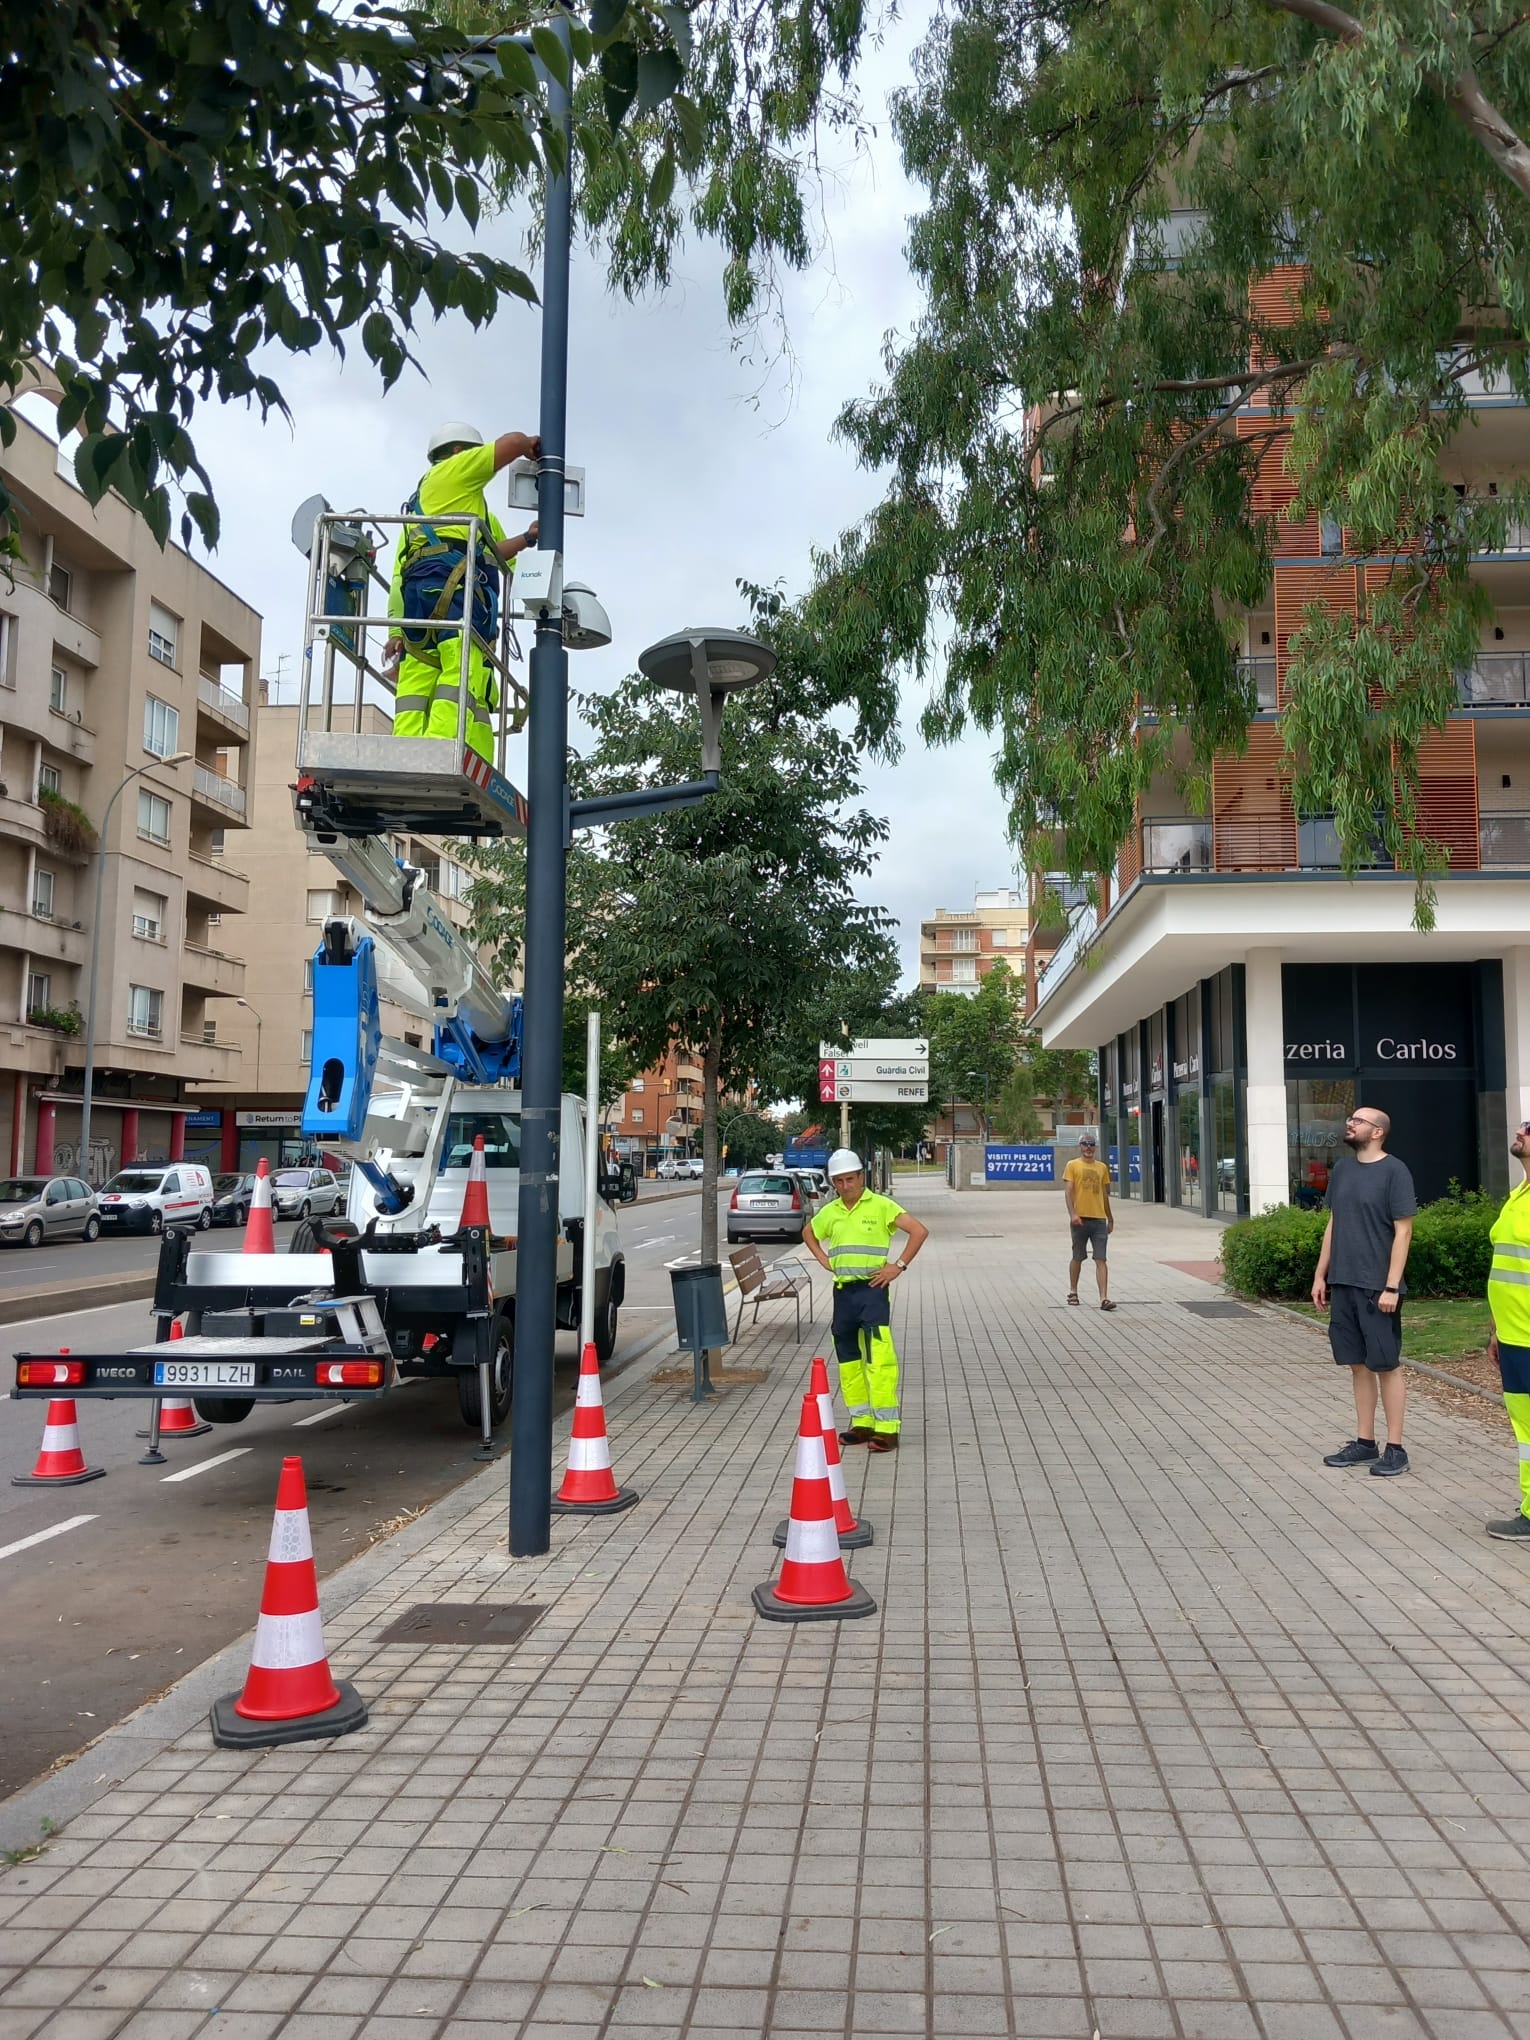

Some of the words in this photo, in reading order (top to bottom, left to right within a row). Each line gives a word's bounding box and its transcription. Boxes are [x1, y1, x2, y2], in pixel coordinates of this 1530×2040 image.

[1283, 1039, 1345, 1060] zeria
[1376, 1037, 1457, 1060] Carlos
[908, 1065, 926, 1075] Civil
[897, 1087, 925, 1097] RENFE
[987, 1162, 1052, 1172] 977772211
[96, 1367, 136, 1378] IVECO
[167, 1365, 209, 1382] 9931
[217, 1366, 250, 1383] LZH
[273, 1368, 306, 1377] DAIL
